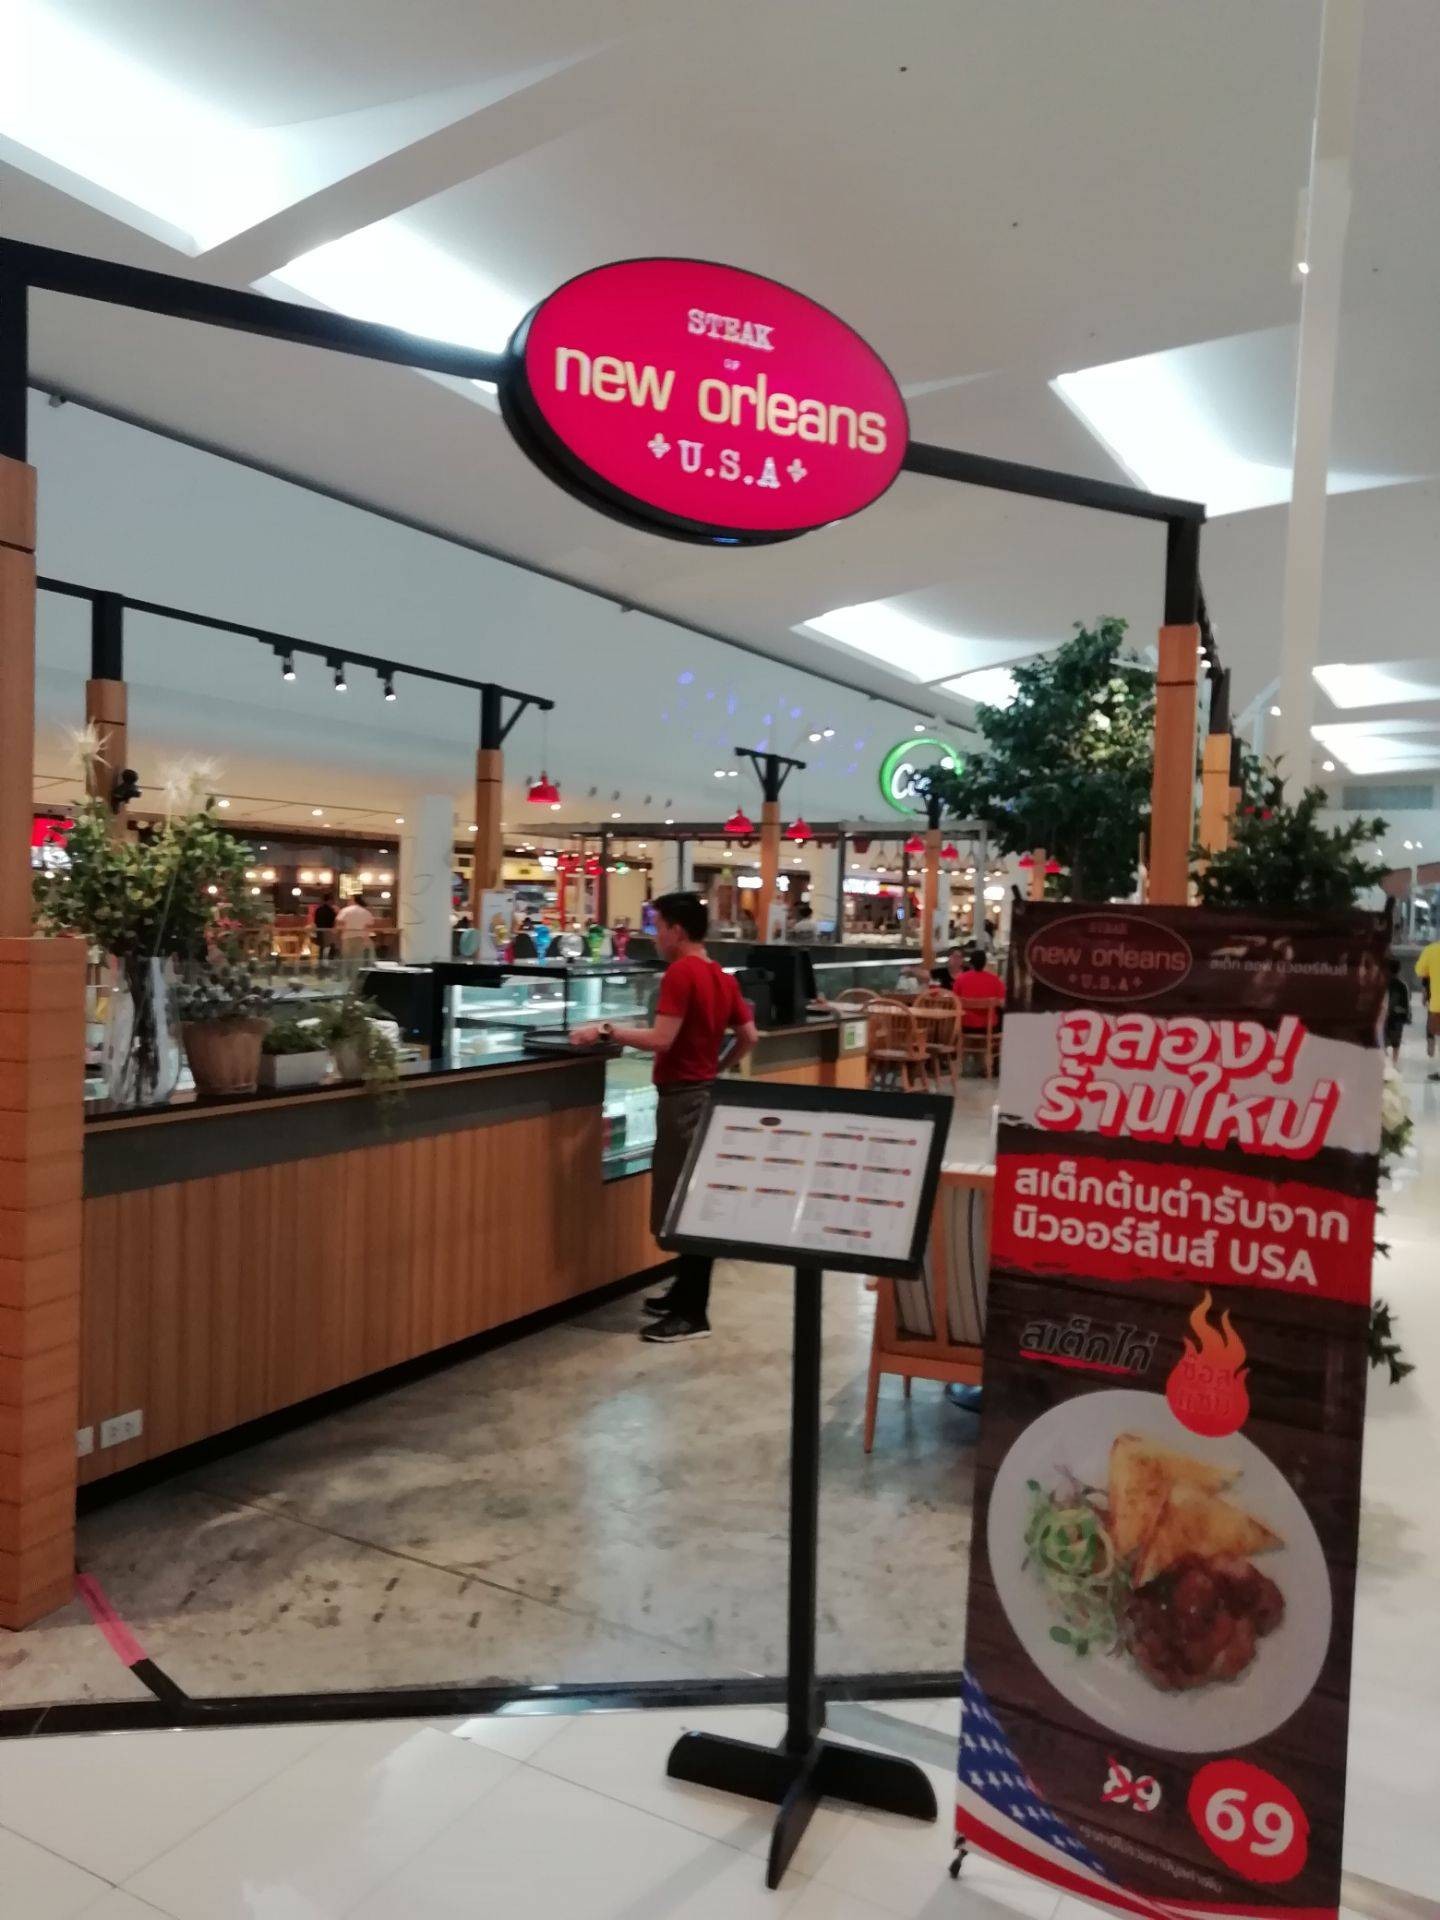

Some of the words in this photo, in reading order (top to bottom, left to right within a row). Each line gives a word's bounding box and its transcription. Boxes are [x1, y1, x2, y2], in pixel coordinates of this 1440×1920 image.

[688, 308, 775, 351] STEAK
[555, 346, 675, 411] new
[698, 372, 887, 454] orleans
[677, 439, 781, 488] U.S.A
[1031, 944, 1082, 967] new
[1091, 943, 1187, 971] orleans
[1057, 1009, 1304, 1080] ฉลอง!
[1036, 1057, 1335, 1154] ร้านใหม่
[1014, 1160, 1350, 1243] สเต็กต้นตำรับจาก
[1012, 1204, 1220, 1269] นิวออร์ลีนส์
[1228, 1239, 1318, 1286] USA
[1019, 1314, 1159, 1374] สเต็กไก่
[1205, 1787, 1294, 1857] 69
